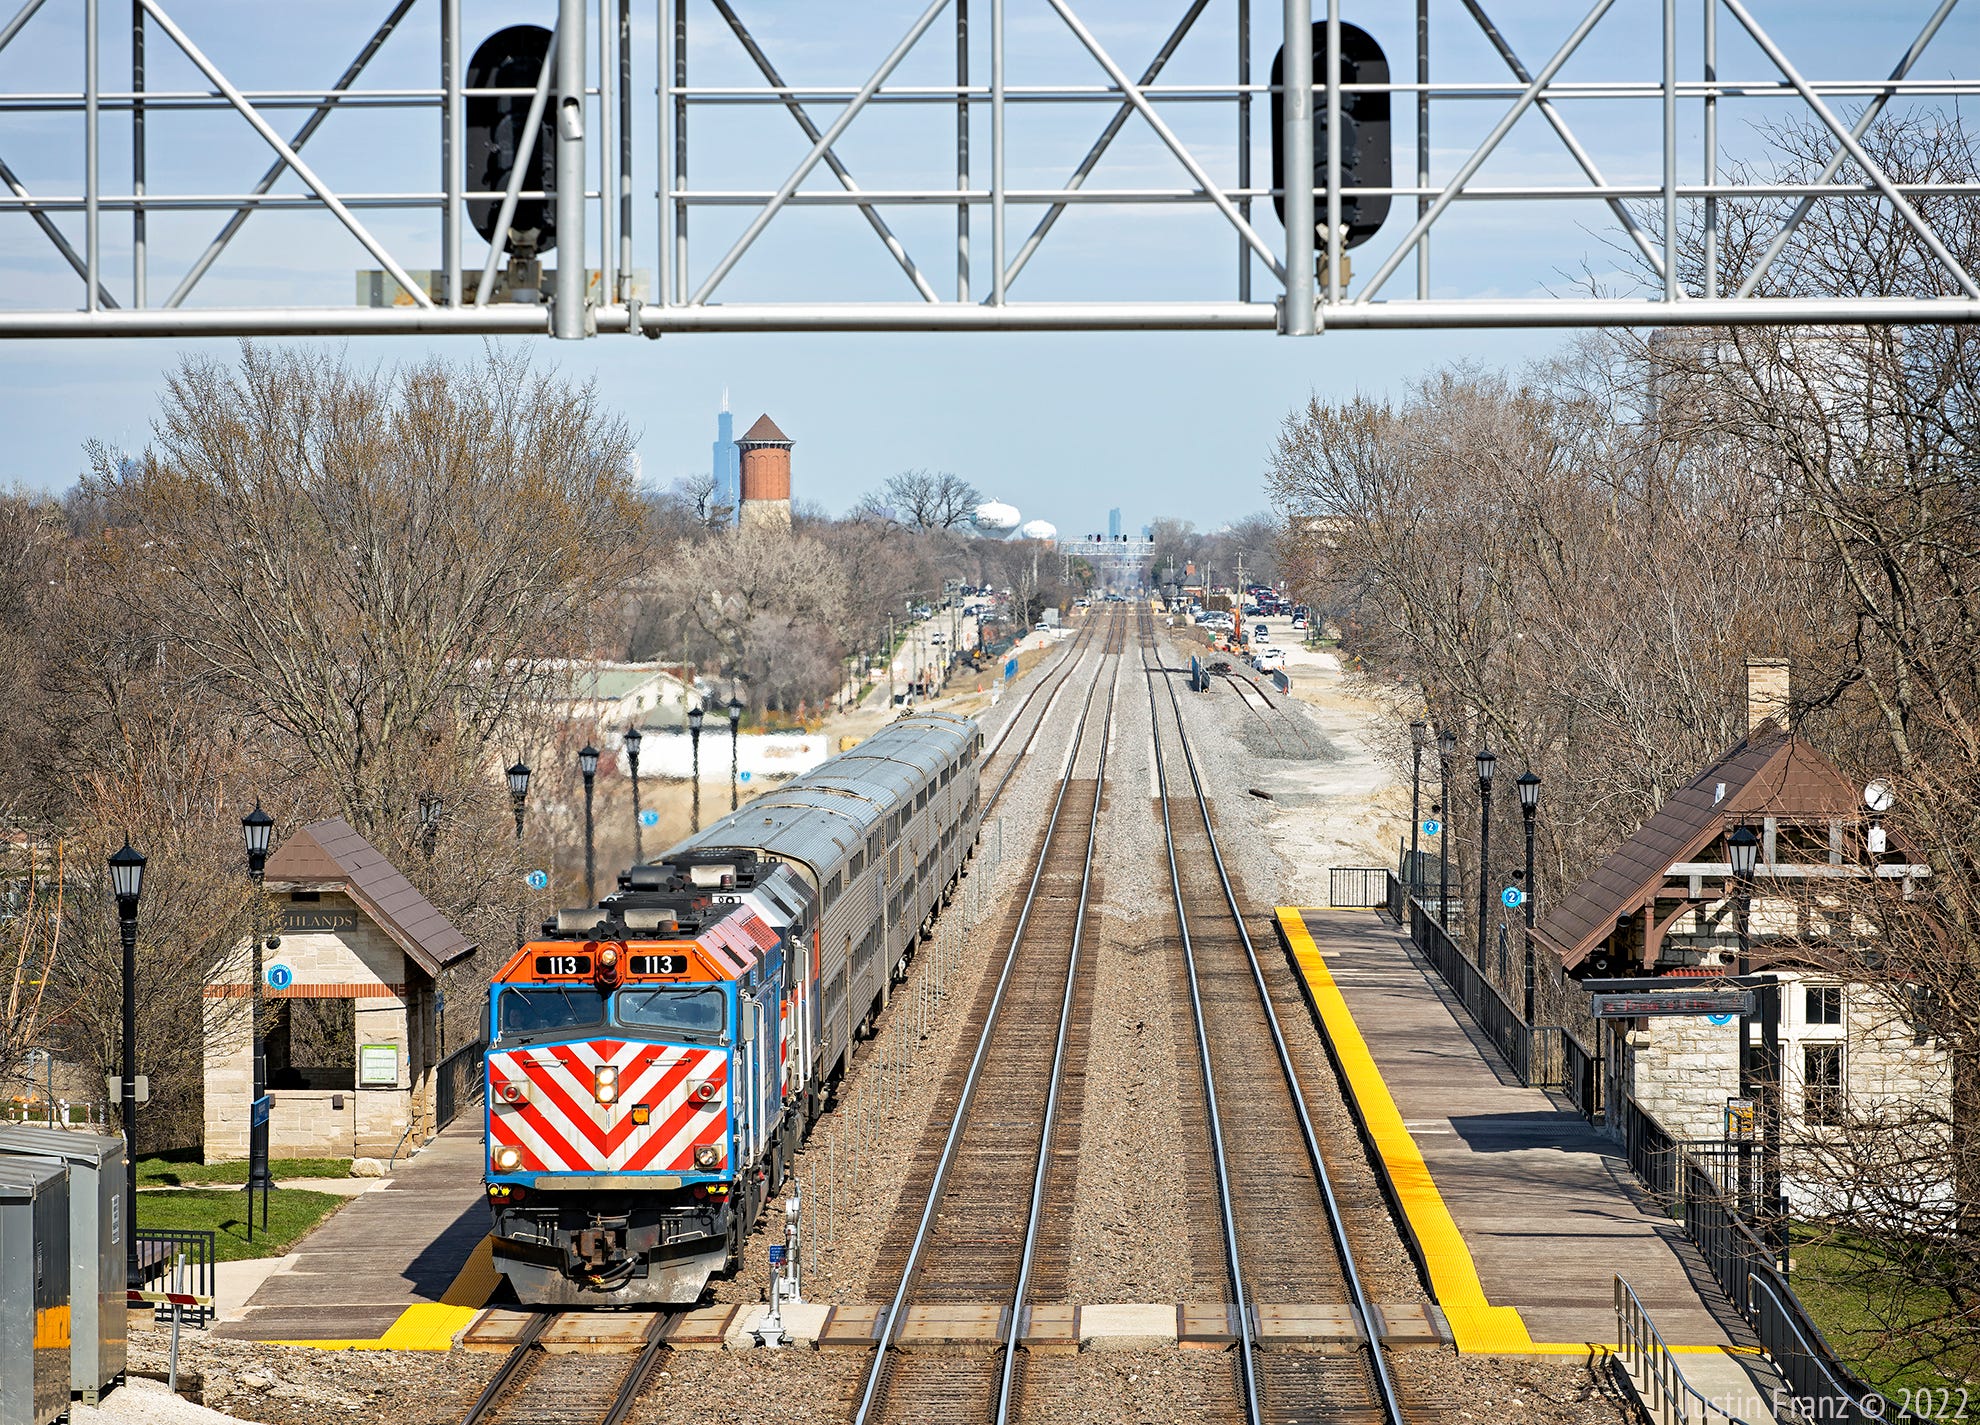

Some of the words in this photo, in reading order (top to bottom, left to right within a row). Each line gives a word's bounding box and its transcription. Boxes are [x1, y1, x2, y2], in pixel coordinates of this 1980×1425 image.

[1508, 892, 1516, 903] 2
[550, 956, 577, 975] 113
[645, 955, 673, 974] 113
[277, 971, 283, 984] 1
